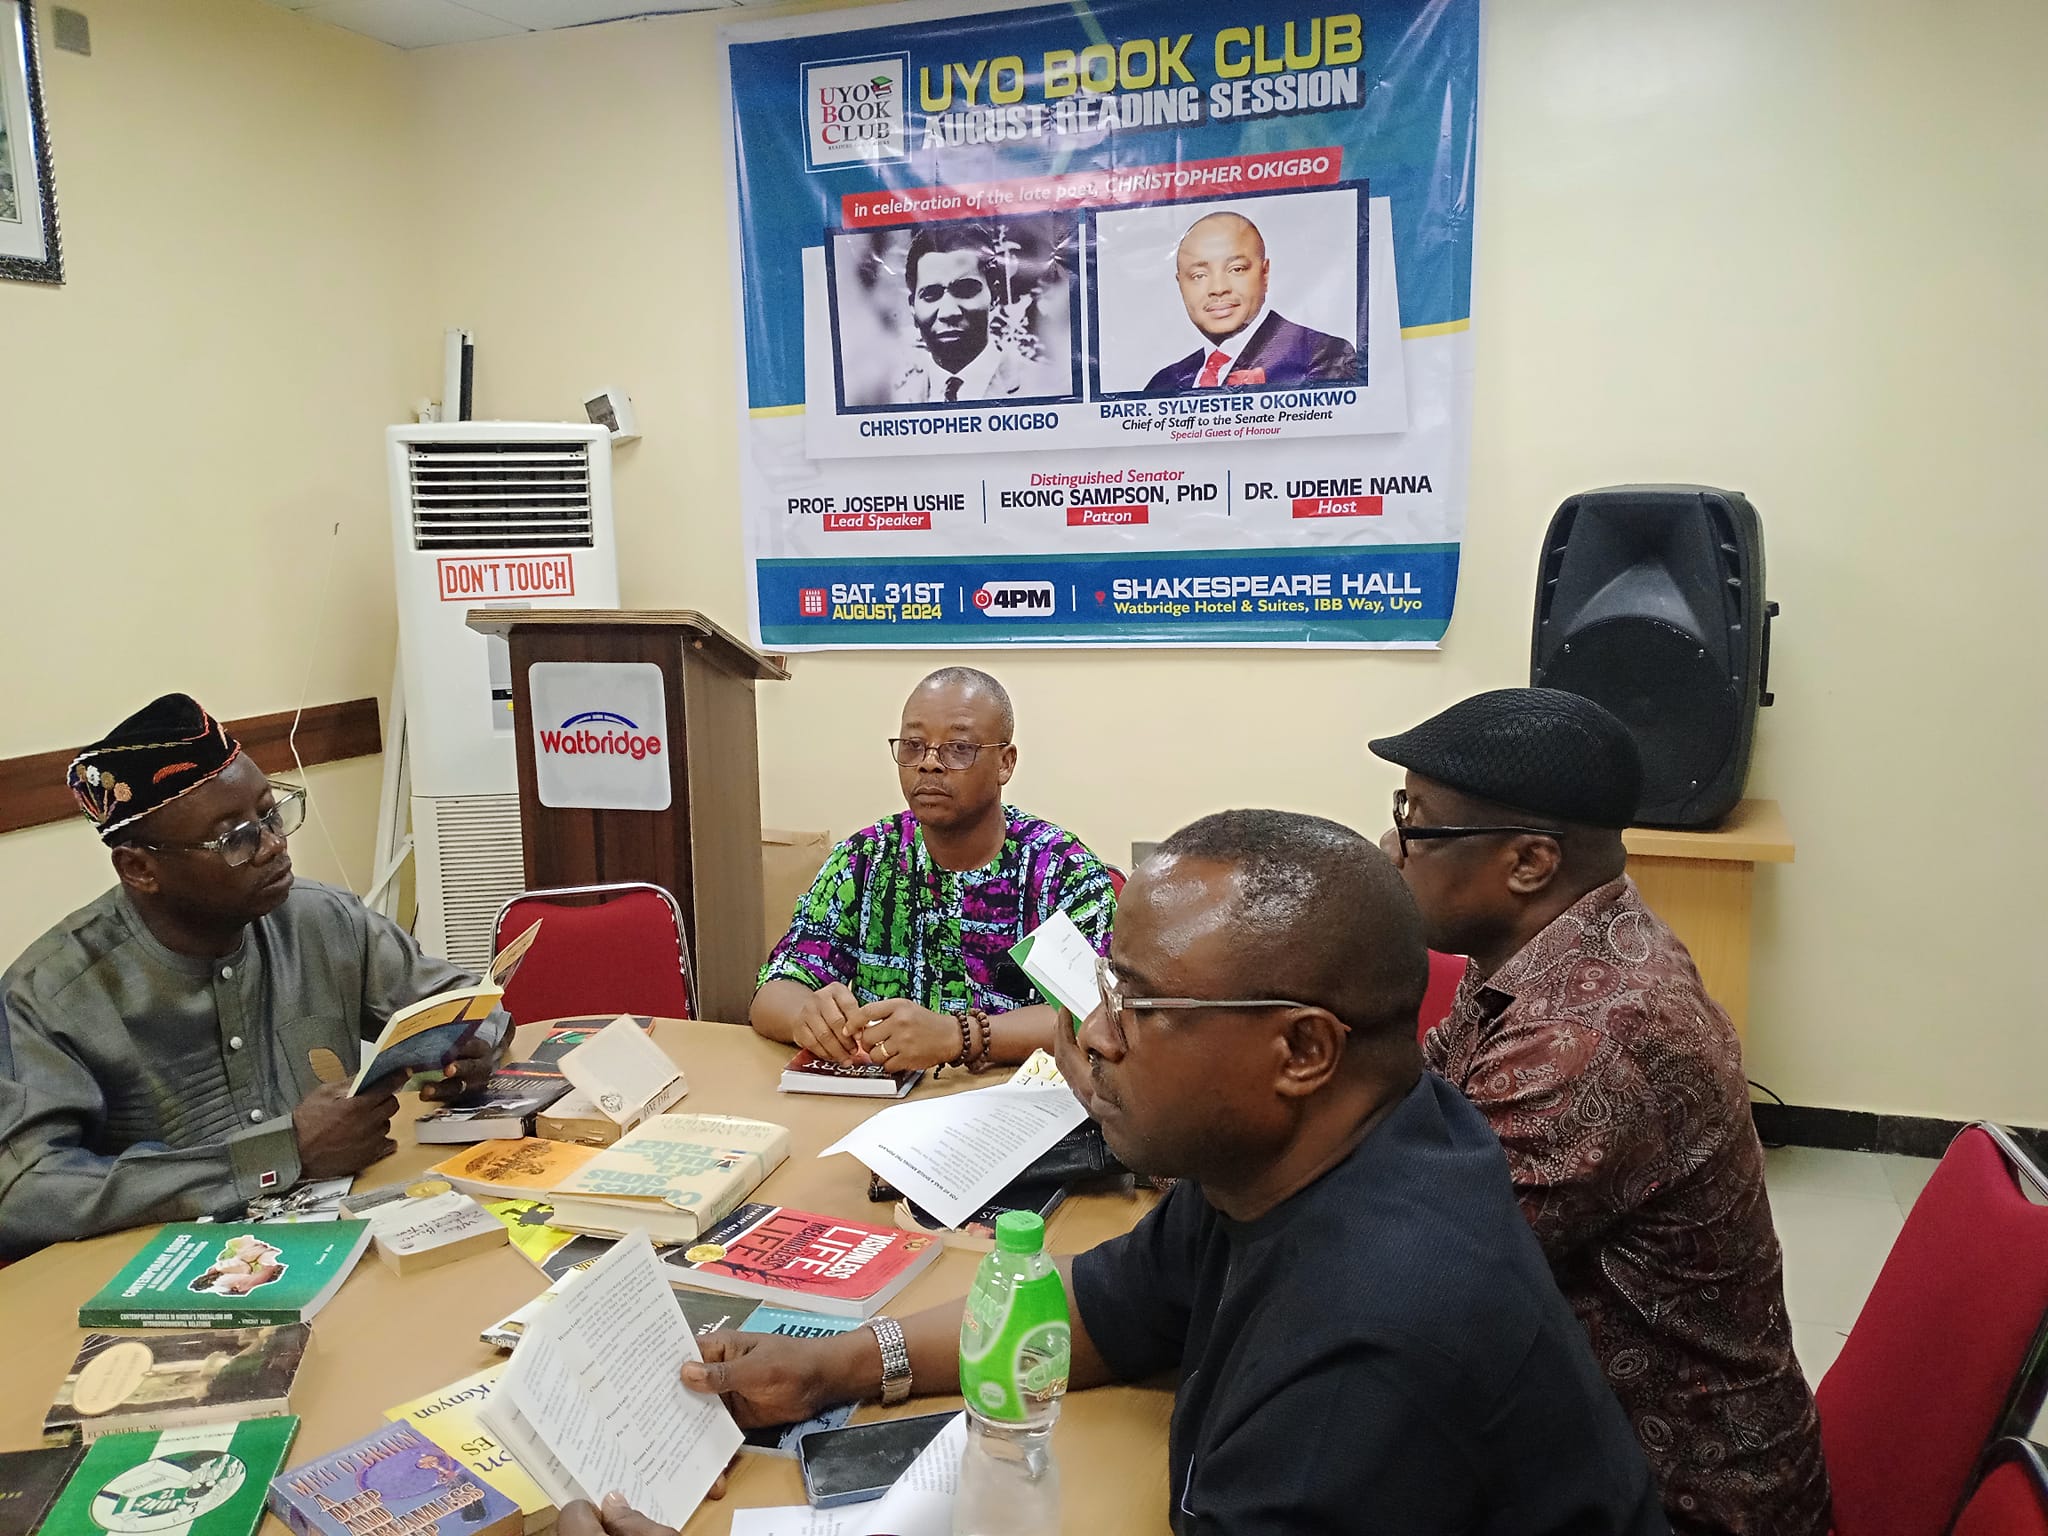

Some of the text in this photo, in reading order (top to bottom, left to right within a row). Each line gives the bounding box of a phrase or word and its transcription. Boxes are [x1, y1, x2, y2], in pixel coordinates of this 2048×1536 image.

[920, 13, 1362, 112] UYO BOOK CLUB
[820, 84, 870, 105] UYO
[822, 100, 891, 124] BOOK
[922, 67, 1357, 150] AUGUST READING SESSION
[822, 122, 890, 144] CLUB
[854, 202, 868, 217] in
[872, 195, 961, 215] celebration
[966, 191, 982, 209] of
[988, 189, 1014, 204] the
[1019, 185, 1050, 201] late
[1105, 165, 1242, 193] CHRISTOPHER
[1248, 156, 1330, 180] OKIGBO
[1100, 389, 1357, 419] BARR. SYLVESTER OKONKWO
[859, 412, 1059, 438] CHRISTOPHER OKIGBO
[1122, 409, 1333, 431] Chief of Staff to the Senate President
[1170, 425, 1281, 441] Special Guest of Honour
[1030, 469, 1185, 489] Distinguished Senator
[1245, 475, 1433, 501] DR. UDEME NANA
[788, 494, 965, 514] PROF. JOSEPH USHIE
[1000, 483, 1218, 508] EKONG SAMPSON, PhD
[1317, 499, 1357, 515] Host
[830, 513, 925, 531] Lead Speaker
[1083, 509, 1133, 523] Patron
[445, 561, 567, 594] DON'T TOUCH
[1112, 573, 1421, 600] SHAKESPEARE HALL
[831, 582, 945, 604] SAT. 31ST
[993, 589, 1051, 609] 4PM
[832, 603, 943, 623] AUGUST, 2024
[1113, 597, 1422, 617] Watbridge Hotel & Suites, IBB Way, Uyo
[539, 729, 662, 761] Watbridge
[803, 1060, 885, 1074] ISTORY
[737, 1204, 766, 1225] SUNDAY
[726, 1214, 809, 1262] LIFE
[783, 1225, 869, 1275] LIFE
[823, 1233, 898, 1280] VISIONLESS
[414, 1382, 492, 1420] Kenyon
[287, 1429, 422, 1498] MEG O'BRIEN
[309, 1491, 337, 1513] A
[327, 1488, 384, 1524] DEEP
[343, 1505, 394, 1536] AND
